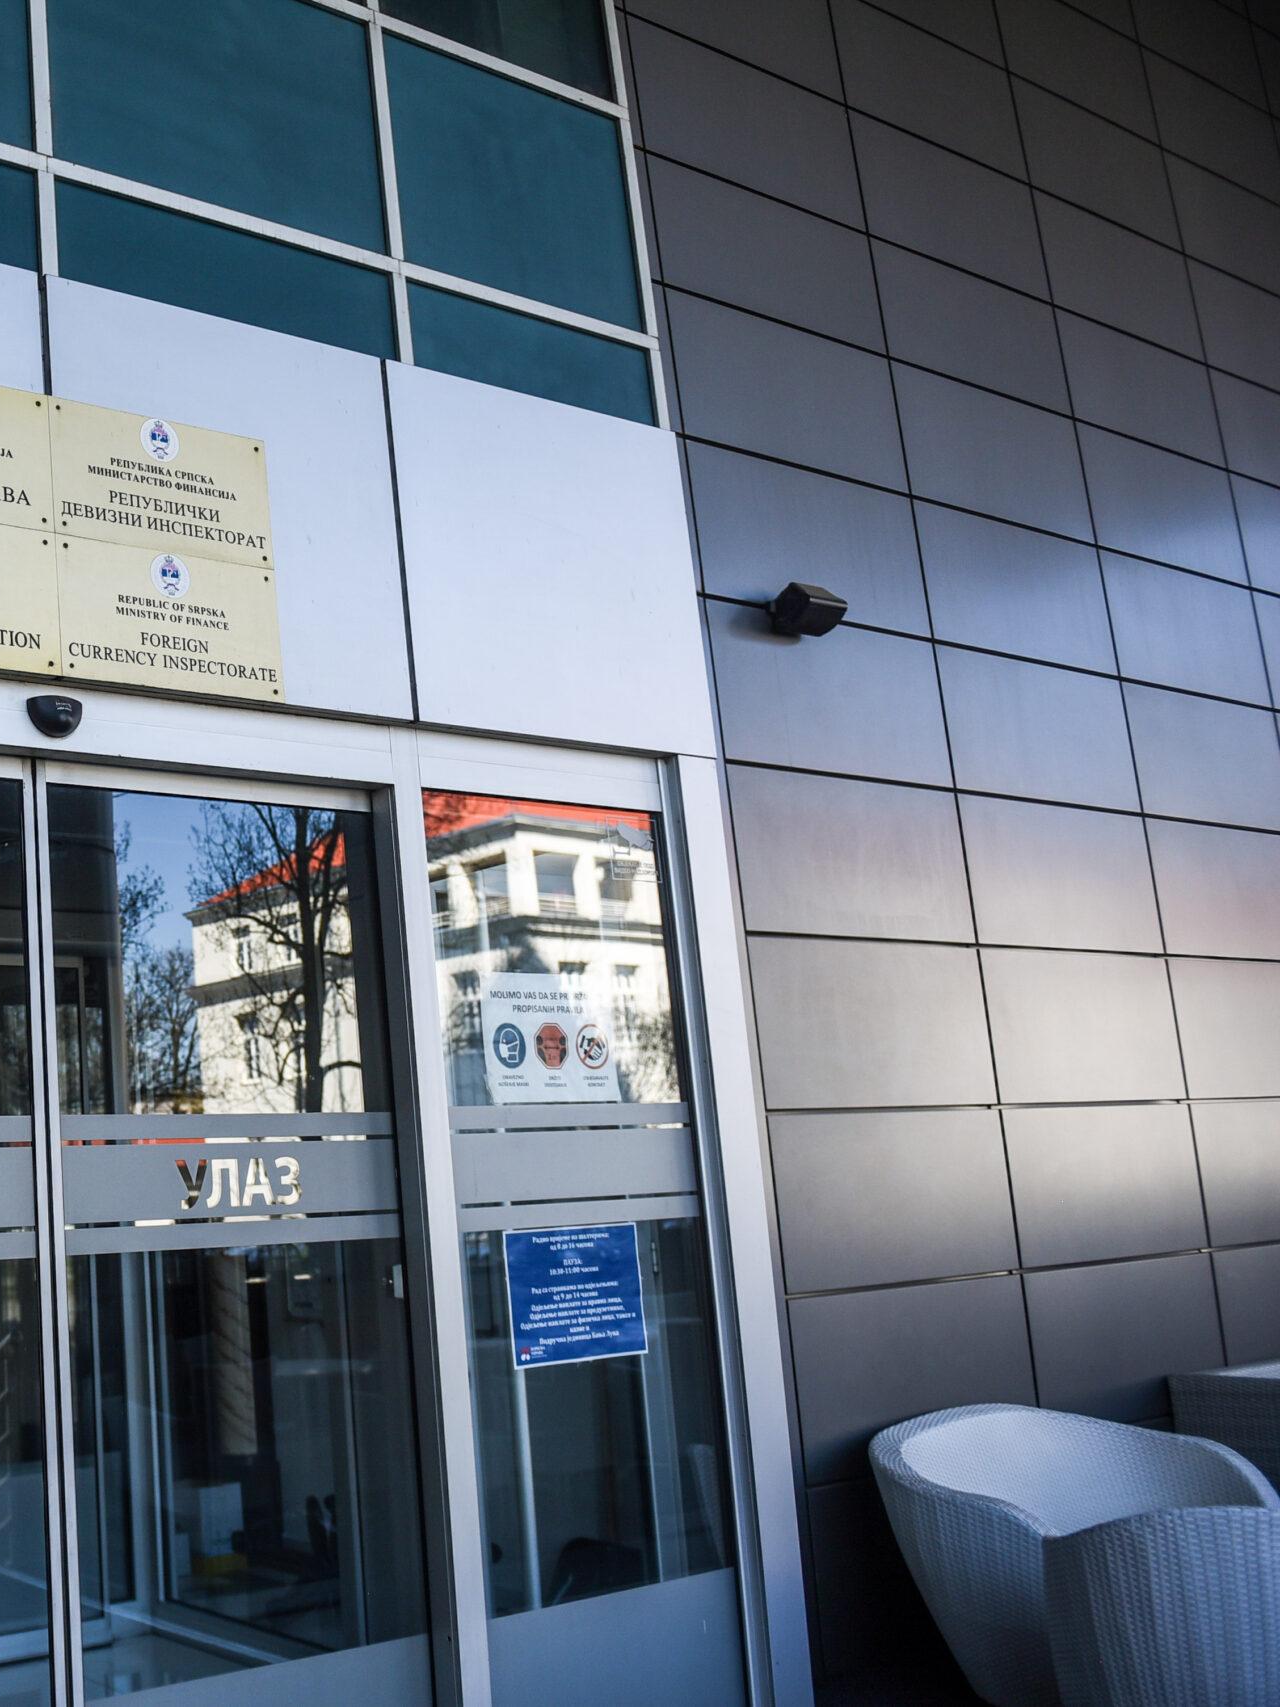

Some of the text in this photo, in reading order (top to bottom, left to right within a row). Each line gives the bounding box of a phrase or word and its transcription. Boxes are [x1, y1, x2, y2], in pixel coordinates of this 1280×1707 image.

[88, 465, 237, 501] МИНИСТАРСТВО ФИНАНСИЈА
[110, 457, 214, 486] РЕПУБЛИКА СРПСКА
[109, 490, 220, 523] РЕПУБЛИЧКИ
[61, 500, 266, 549] ДЕВИЗНИ ИНСПЕКТОРАТ
[116, 606, 230, 631] MINISTRY OF FINANCE
[118, 594, 225, 619] REPUBLIC OF SRPSKA
[140, 632, 209, 654] FOREIGN
[68, 642, 278, 682] CURRENCY INSPECTORATE
[490, 990, 521, 1000] MOLIMO
[522, 991, 537, 1000] VAS
[538, 992, 548, 1000] DA
[549, 992, 558, 1000] SE
[512, 1004, 555, 1013] PROPISANIH
[174, 1156, 302, 1210] УЛАЗ
